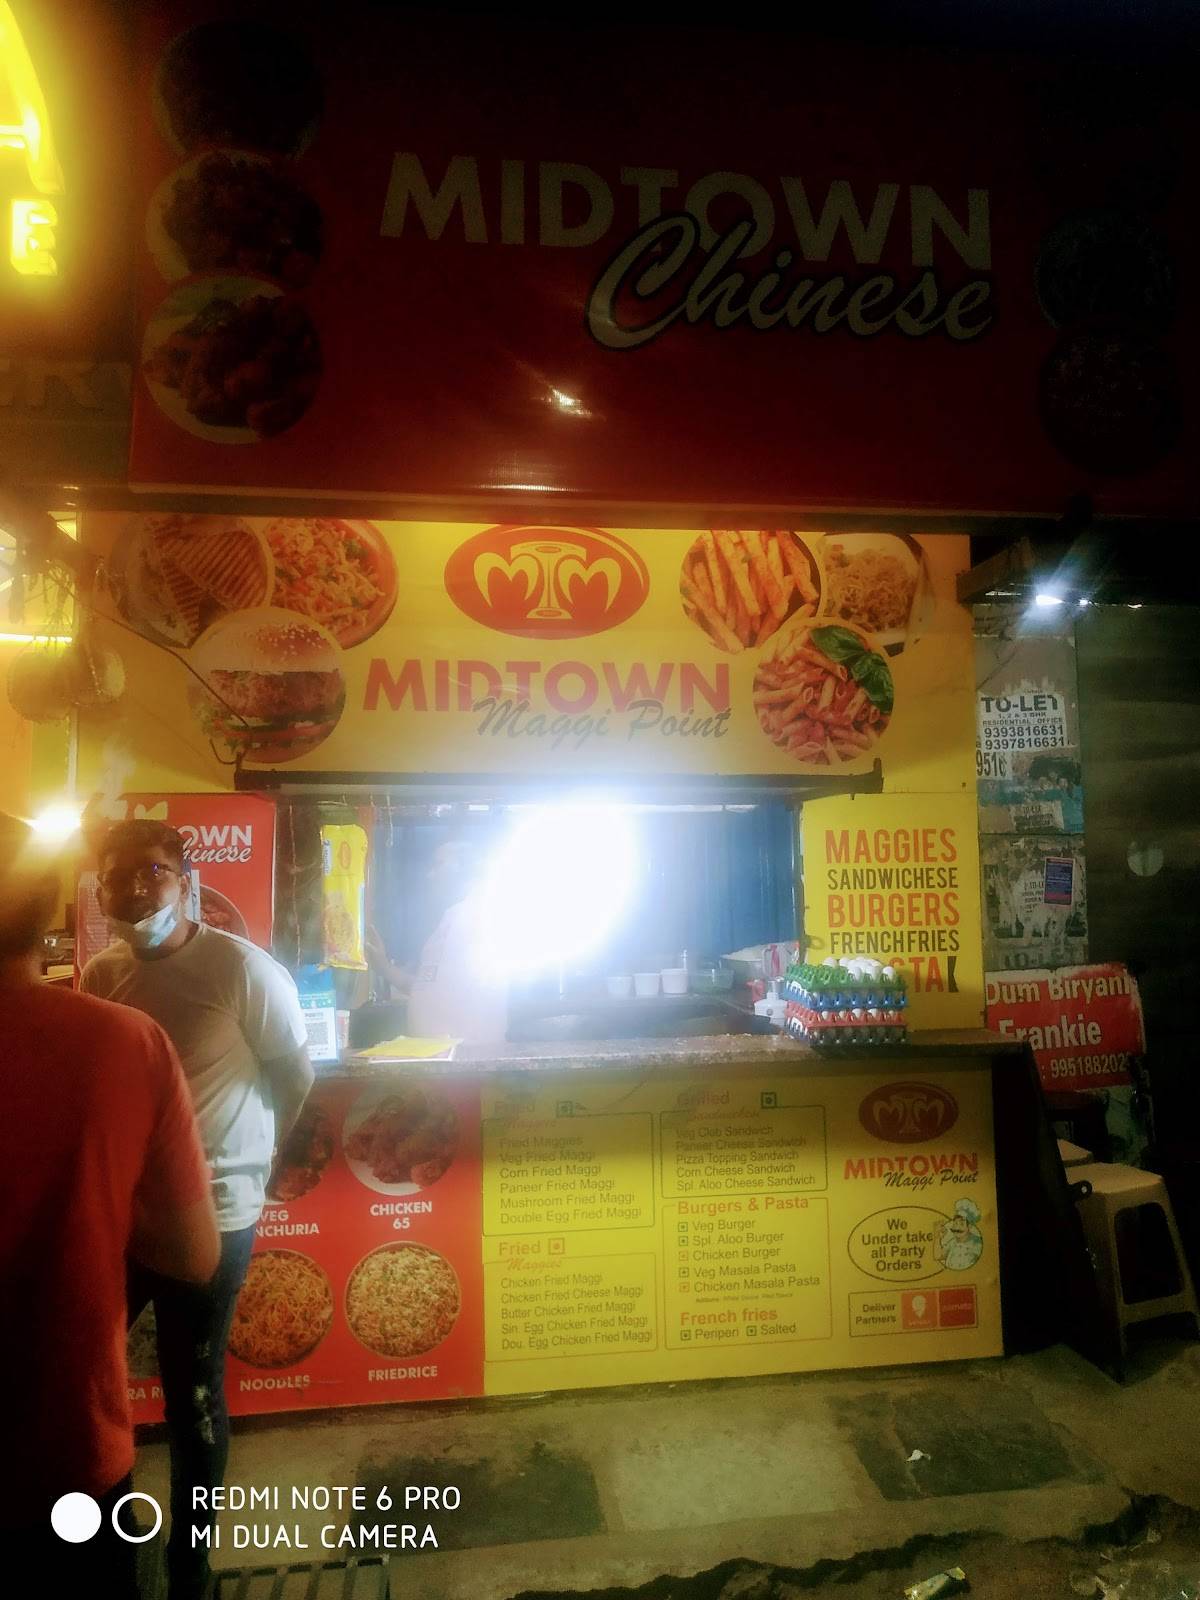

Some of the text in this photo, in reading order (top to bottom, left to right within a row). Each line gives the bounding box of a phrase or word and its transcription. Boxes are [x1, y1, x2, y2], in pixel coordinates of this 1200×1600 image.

[380, 151, 992, 270] MIDTOWN
[587, 212, 992, 349] Chinese
[362, 658, 732, 713] MIDTOWN
[473, 697, 732, 750] Maggi Point
[984, 725, 1063, 738] 9393816631
[985, 736, 1065, 750] 9397816631
[824, 828, 958, 865] MAGGIES
[827, 867, 958, 890] SANDWICHESE
[827, 892, 960, 928] BURGERS
[985, 981, 1040, 1005] Dum
[998, 1014, 1102, 1051] Frankie
[1050, 1054, 1129, 1079] 995188202
[676, 1150, 799, 1165] Pizza Topping Sandwich
[843, 1152, 978, 1180] MIDTOWN
[499, 1164, 601, 1179] Corn Fried Maggi
[676, 1163, 795, 1178] Corn Cheese Sandwich
[500, 1178, 615, 1194] Paneer Fried Maggi
[698, 1178, 722, 1189] Aloo
[725, 1177, 764, 1188] Cheese
[767, 1175, 816, 1186] Sandwich
[883, 1169, 979, 1191] Maggi Point
[370, 1200, 432, 1217] CHICKEN
[500, 1192, 634, 1209] Mushroom Fried Maggi
[678, 1196, 808, 1216] Burgers & Pasta
[393, 1217, 410, 1230] 65
[500, 1206, 641, 1224] Double Egg Fried Maggi
[692, 1219, 755, 1232] Veg Burger
[887, 1218, 908, 1230] We
[717, 1233, 743, 1244] Aloo
[746, 1232, 784, 1245] Burger
[862, 1230, 934, 1245] Under take
[499, 1241, 541, 1256] Fried
[692, 1247, 781, 1261] Chicken Burger
[871, 1246, 926, 1259] all Party
[693, 1262, 796, 1279] Veg Masala Pasta
[876, 1259, 922, 1273] Orders
[500, 1273, 602, 1289] Chicken Fried Maggi
[694, 1276, 820, 1293] Chicken Masala Pasta
[501, 1285, 643, 1304] Chicken Fried Cheese Maggi
[501, 1301, 635, 1319] Butter Chicken Fried Maggi
[680, 1307, 778, 1326] French fries
[862, 1303, 896, 1314] Deliver
[524, 1322, 544, 1335] Egg
[547, 1319, 587, 1331] Chicken
[590, 1316, 615, 1328] Fried
[761, 1322, 797, 1335] Salted
[855, 1315, 897, 1325] Partners
[528, 1336, 548, 1350] Egg
[551, 1334, 591, 1346] Chicken
[594, 1331, 619, 1343] Fried
[368, 1366, 438, 1381] FRIEDRICE
[239, 1374, 311, 1392] NOODLES
